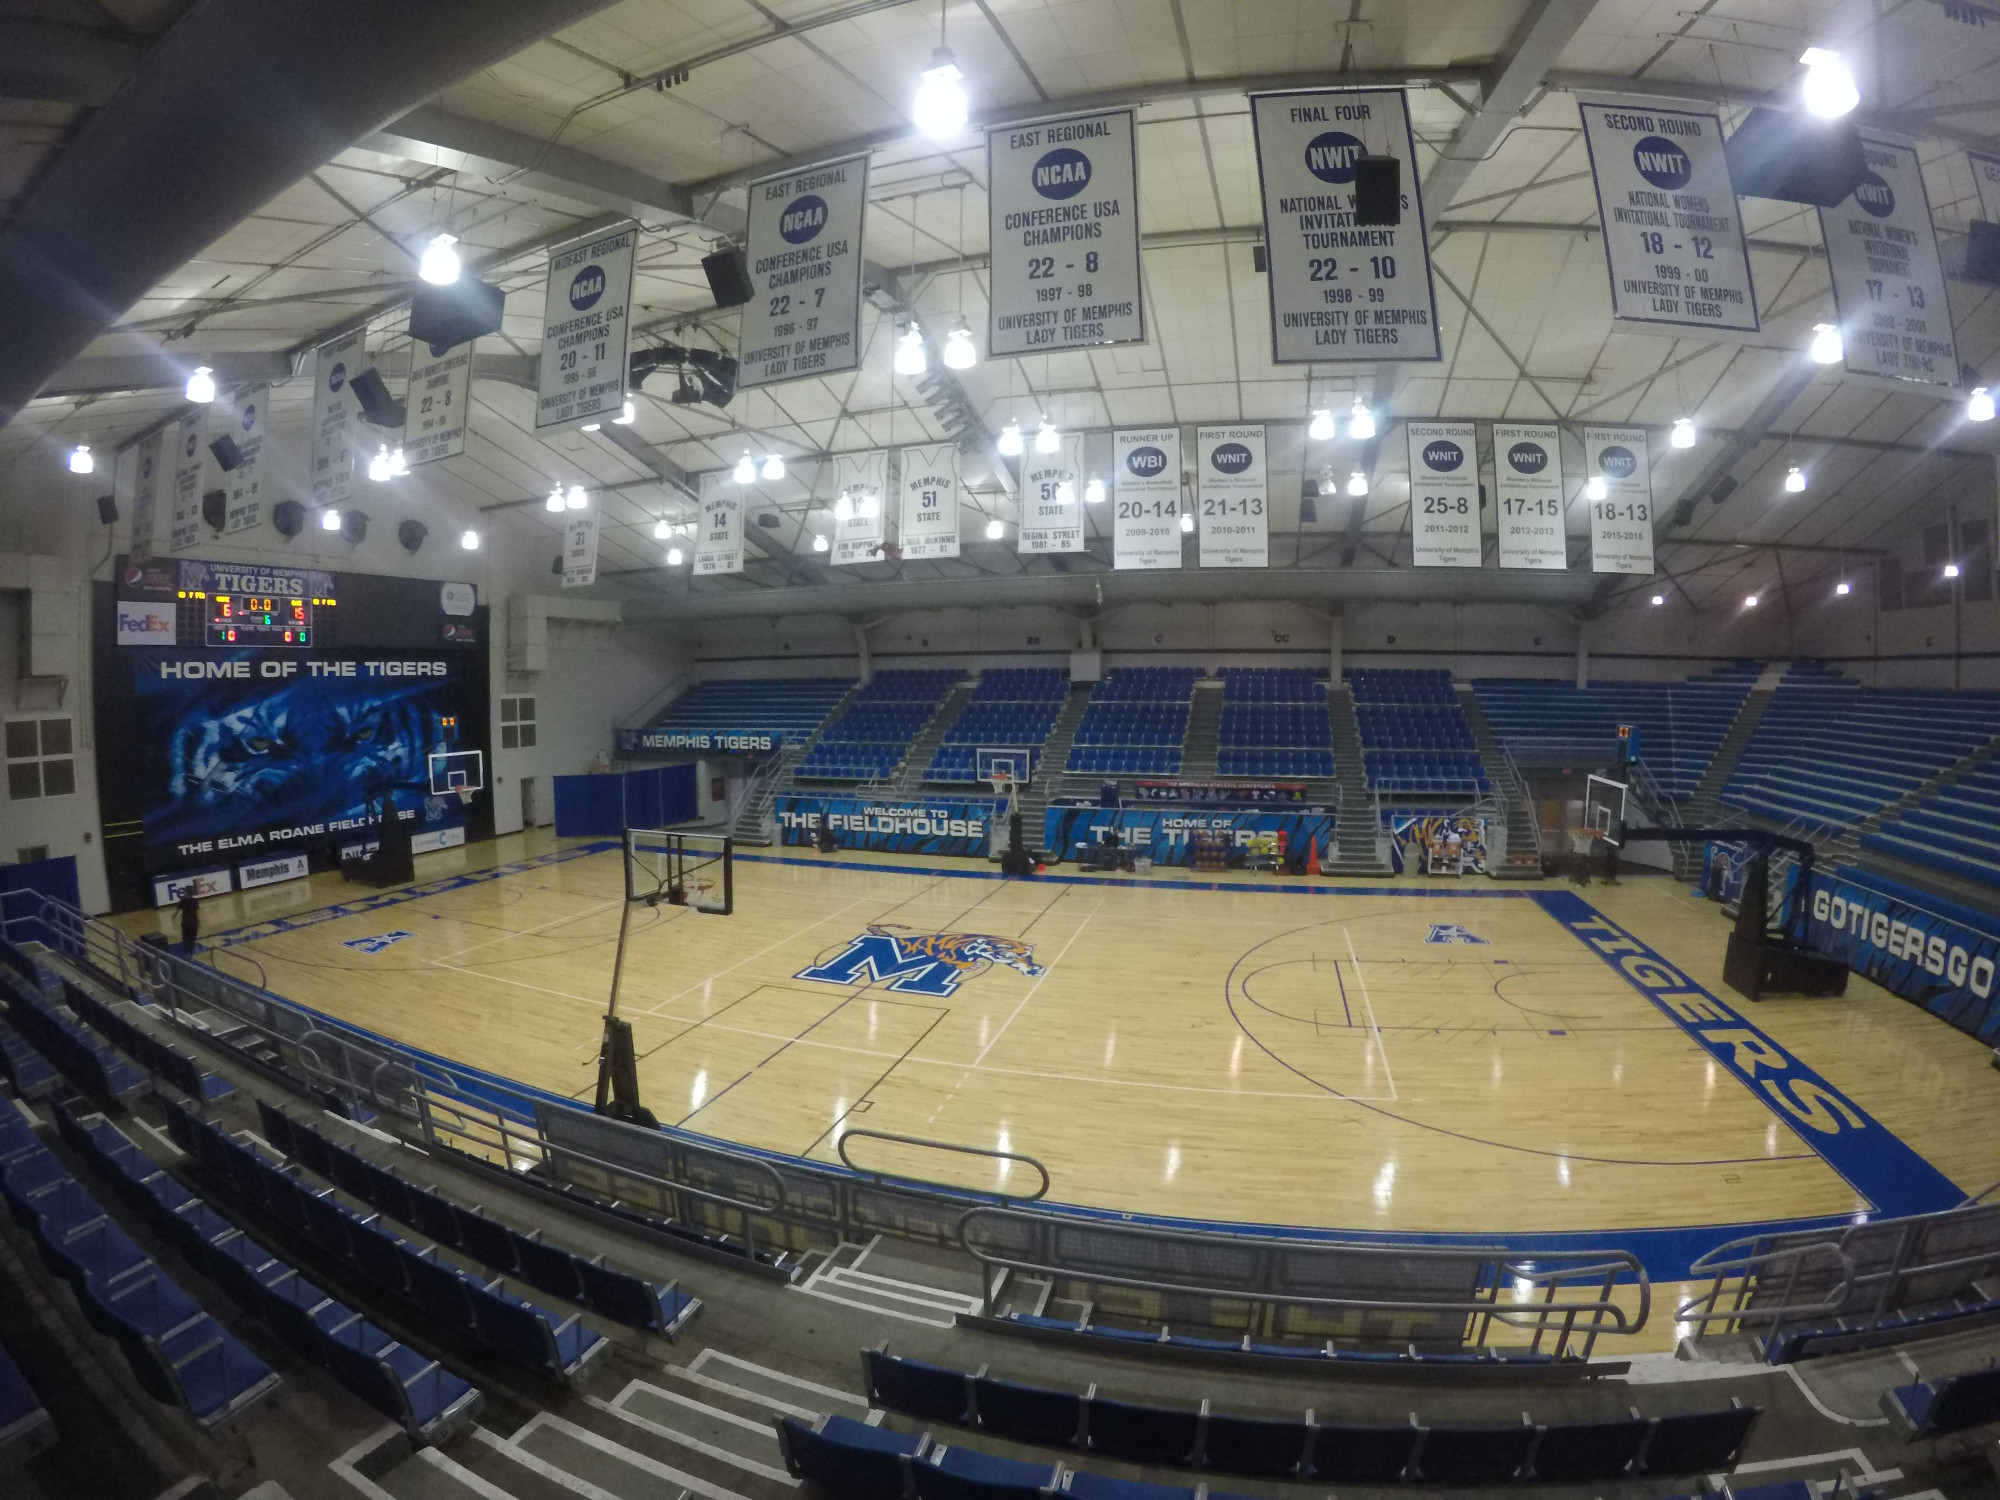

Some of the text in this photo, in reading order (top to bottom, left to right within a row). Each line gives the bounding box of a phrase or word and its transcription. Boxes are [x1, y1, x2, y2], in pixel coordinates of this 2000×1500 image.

[1290, 105, 1371, 123] FINAL FOUR
[1605, 114, 1701, 136] SECOND ROUND
[1011, 122, 1110, 149] EAST REGIONAL
[1637, 152, 1683, 174] NWIT
[1037, 162, 1086, 186] NCAA
[766, 169, 847, 200] EAST REGIONAL
[1280, 196, 1341, 213] NATIONAL
[1629, 191, 1669, 208] NATIONAL
[784, 207, 822, 232] NCAA
[1006, 200, 1120, 230] CONFERENCE USA
[1614, 207, 1730, 232] INVITATIONAL TOURNAMENT
[1024, 222, 1101, 246] CHAMPIONS
[1303, 231, 1395, 249] TOURNAMENT
[554, 236, 630, 271] MIDEAST REGIONAL
[1640, 232, 1714, 259] 18 12
[756, 241, 848, 273] CONFERENCE USA
[1029, 251, 1098, 279] 22 8
[769, 262, 831, 289] CHAMPIONS
[1309, 256, 1396, 281] 22 10
[1655, 265, 1708, 282] 1999 00
[573, 276, 602, 300] NCAA
[1037, 284, 1092, 302] 1997 98
[1324, 288, 1384, 303] 1998 99
[1624, 280, 1743, 303] UNIVERSITY OF MEMPHIS
[1866, 280, 1925, 309] 17 13
[770, 288, 825, 317] 22 7
[1653, 299, 1722, 318] LADY TIGERS
[547, 306, 623, 338] CONFERENCE USA
[999, 303, 1132, 330] UNIVERSITY OF MEMPHIS
[1283, 310, 1426, 327] UNIVERSITY OF MEMPHIS
[774, 318, 818, 337] 1996 97
[1027, 323, 1103, 344] LADY TIGERS
[559, 325, 609, 349] CHAMPIONS
[1315, 329, 1398, 345] LADY TIGERS
[1903, 338, 1912, 348] OF
[561, 343, 605, 370] 20 11
[744, 333, 849, 365] UNIVERSITY OF MEMPHIS
[765, 354, 825, 376] LADY TIGERS
[564, 370, 579, 384] 1995
[421, 390, 451, 414] 22 8
[542, 380, 618, 409] UNIVERSITY OF MEMPHIS
[557, 399, 600, 419] LADY TIGERS
[1120, 435, 1158, 443] RUNNER
[1132, 456, 1162, 468] WBI
[1217, 453, 1247, 463] WNIT
[1428, 452, 1458, 461] WNIT
[1513, 453, 1542, 463] WNIT
[1604, 458, 1632, 466] WNIT
[910, 477, 951, 491] MEMPHIS
[705, 500, 737, 513] MEMPHIS
[922, 491, 936, 507] 51
[1204, 499, 1263, 515] 21-13
[1424, 497, 1468, 514] 25-8
[1503, 499, 1558, 516] 17-15
[917, 512, 941, 522] STATE
[1039, 506, 1063, 516] STATE
[1119, 501, 1176, 518] 20-14
[1595, 503, 1647, 521] 18-13
[715, 513, 726, 528] 14
[848, 518, 869, 528] STATE
[1425, 525, 1468, 533] 2011-2012
[576, 532, 584, 545] 31
[710, 532, 728, 540] STATE
[1023, 530, 1080, 540] REGINA STREET
[1126, 528, 1169, 536] 2009-2010
[1061, 540, 1070, 548] 85
[210, 564, 308, 578] UNIVERSITY OF MEMPHIS
[215, 573, 303, 595] TIGERS
[251, 599, 271, 611] 0.0
[120, 614, 169, 632] FedEx
[161, 661, 447, 679] HOME OF THE TIGERS
[643, 735, 771, 749] MEMPHIS TIGERS
[864, 807, 947, 819] WELCOME TO
[779, 812, 983, 837] THE FIELDHOUSE
[1163, 819, 1232, 828] HOME OF
[178, 842, 212, 855] THE
[218, 834, 264, 850] ELMA
[270, 824, 325, 840] ROANE
[247, 863, 289, 881] Memphis
[1570, 916, 1865, 1134] TIGERS
